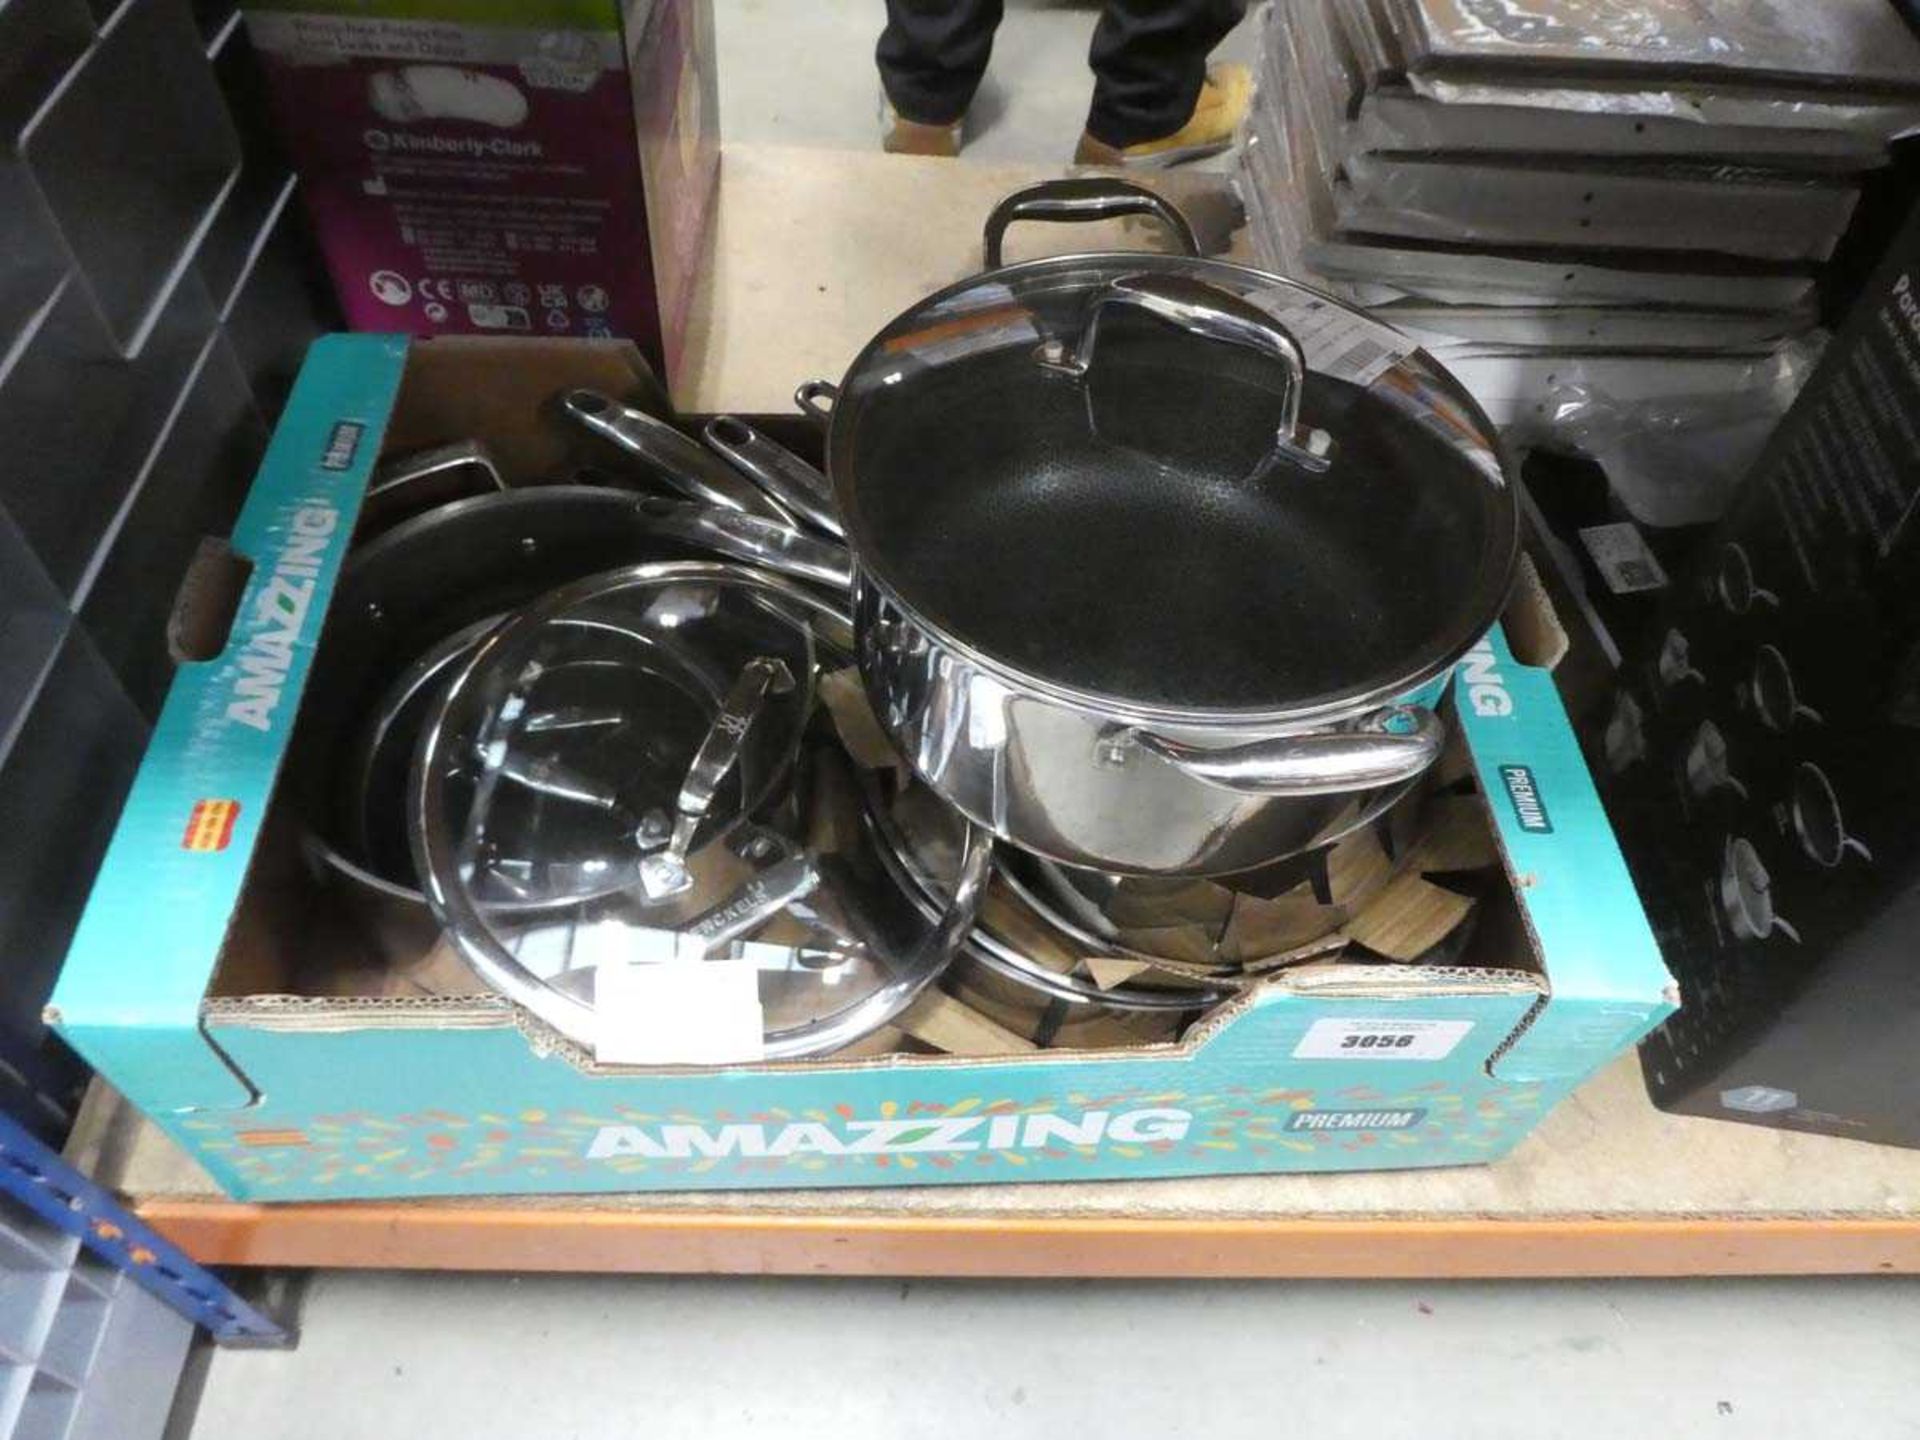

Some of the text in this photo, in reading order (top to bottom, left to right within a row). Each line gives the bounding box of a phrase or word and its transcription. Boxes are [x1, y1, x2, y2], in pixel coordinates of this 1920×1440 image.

[228, 508, 340, 731] AMAZZING
[1503, 768, 1547, 828] PREMIUM
[1341, 1034, 1416, 1049] 3056
[586, 1107, 1193, 1159] AMAZZING
[1292, 1110, 1414, 1130] PREMIUM
